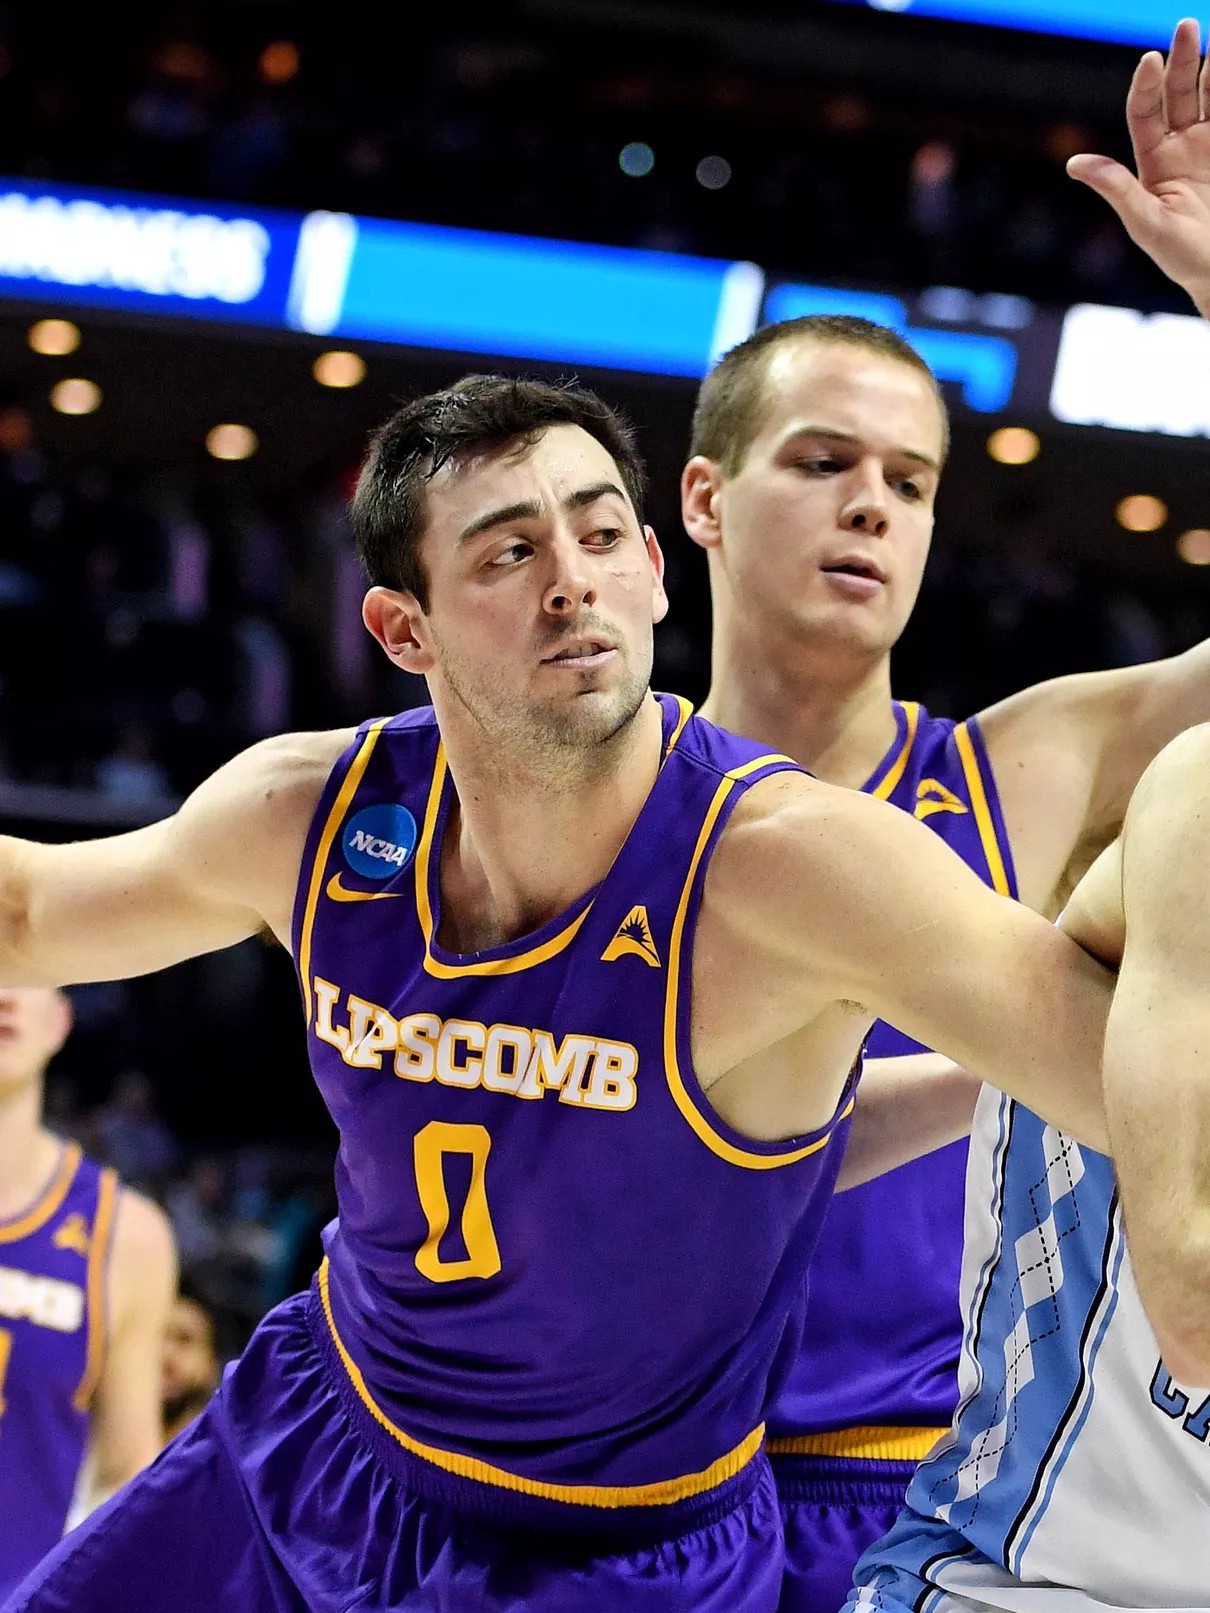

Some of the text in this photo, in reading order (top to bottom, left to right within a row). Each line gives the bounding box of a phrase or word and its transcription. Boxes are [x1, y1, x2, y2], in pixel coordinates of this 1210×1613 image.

[349, 830, 408, 867] NCAA
[313, 976, 640, 1112] LIPSCOMB
[414, 1120, 502, 1283] 0
